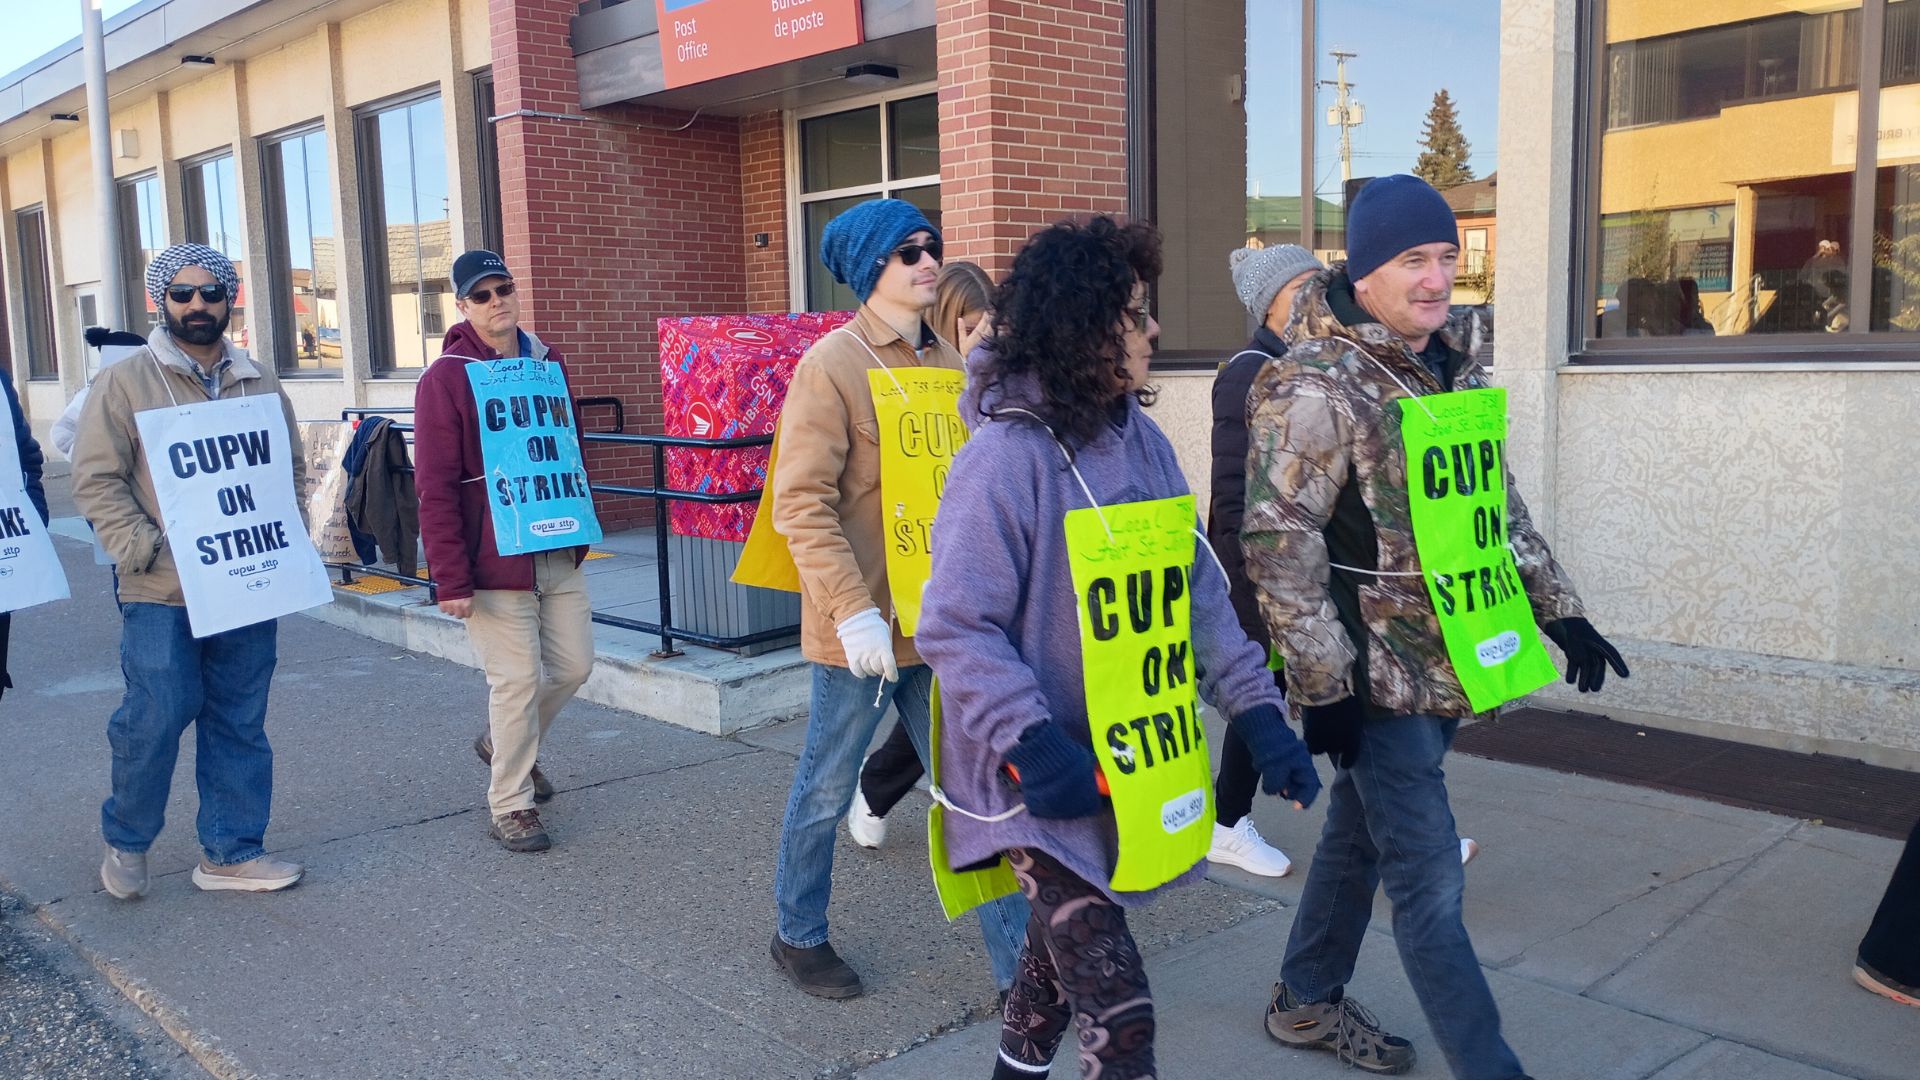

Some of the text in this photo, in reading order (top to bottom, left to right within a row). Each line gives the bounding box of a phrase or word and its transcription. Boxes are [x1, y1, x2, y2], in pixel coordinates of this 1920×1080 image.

[674, 17, 697, 38] Post
[774, 11, 824, 39] de poste
[677, 41, 708, 63] Office
[489, 360, 524, 373] Local
[662, 358, 679, 389] H9X
[751, 376, 776, 405] G5N
[485, 394, 569, 432] CUPW
[739, 408, 756, 433] A1B
[526, 435, 559, 462] ON
[900, 411, 970, 457] CUP
[168, 430, 271, 479] CUPW
[217, 483, 256, 517] ON
[495, 472, 586, 506] STRIKE
[532, 522, 555, 532] cupw
[1474, 504, 1501, 550] ON
[196, 521, 289, 566] STRIKE
[229, 559, 278, 577] cupw sttp
[1142, 640, 1187, 697] ON
